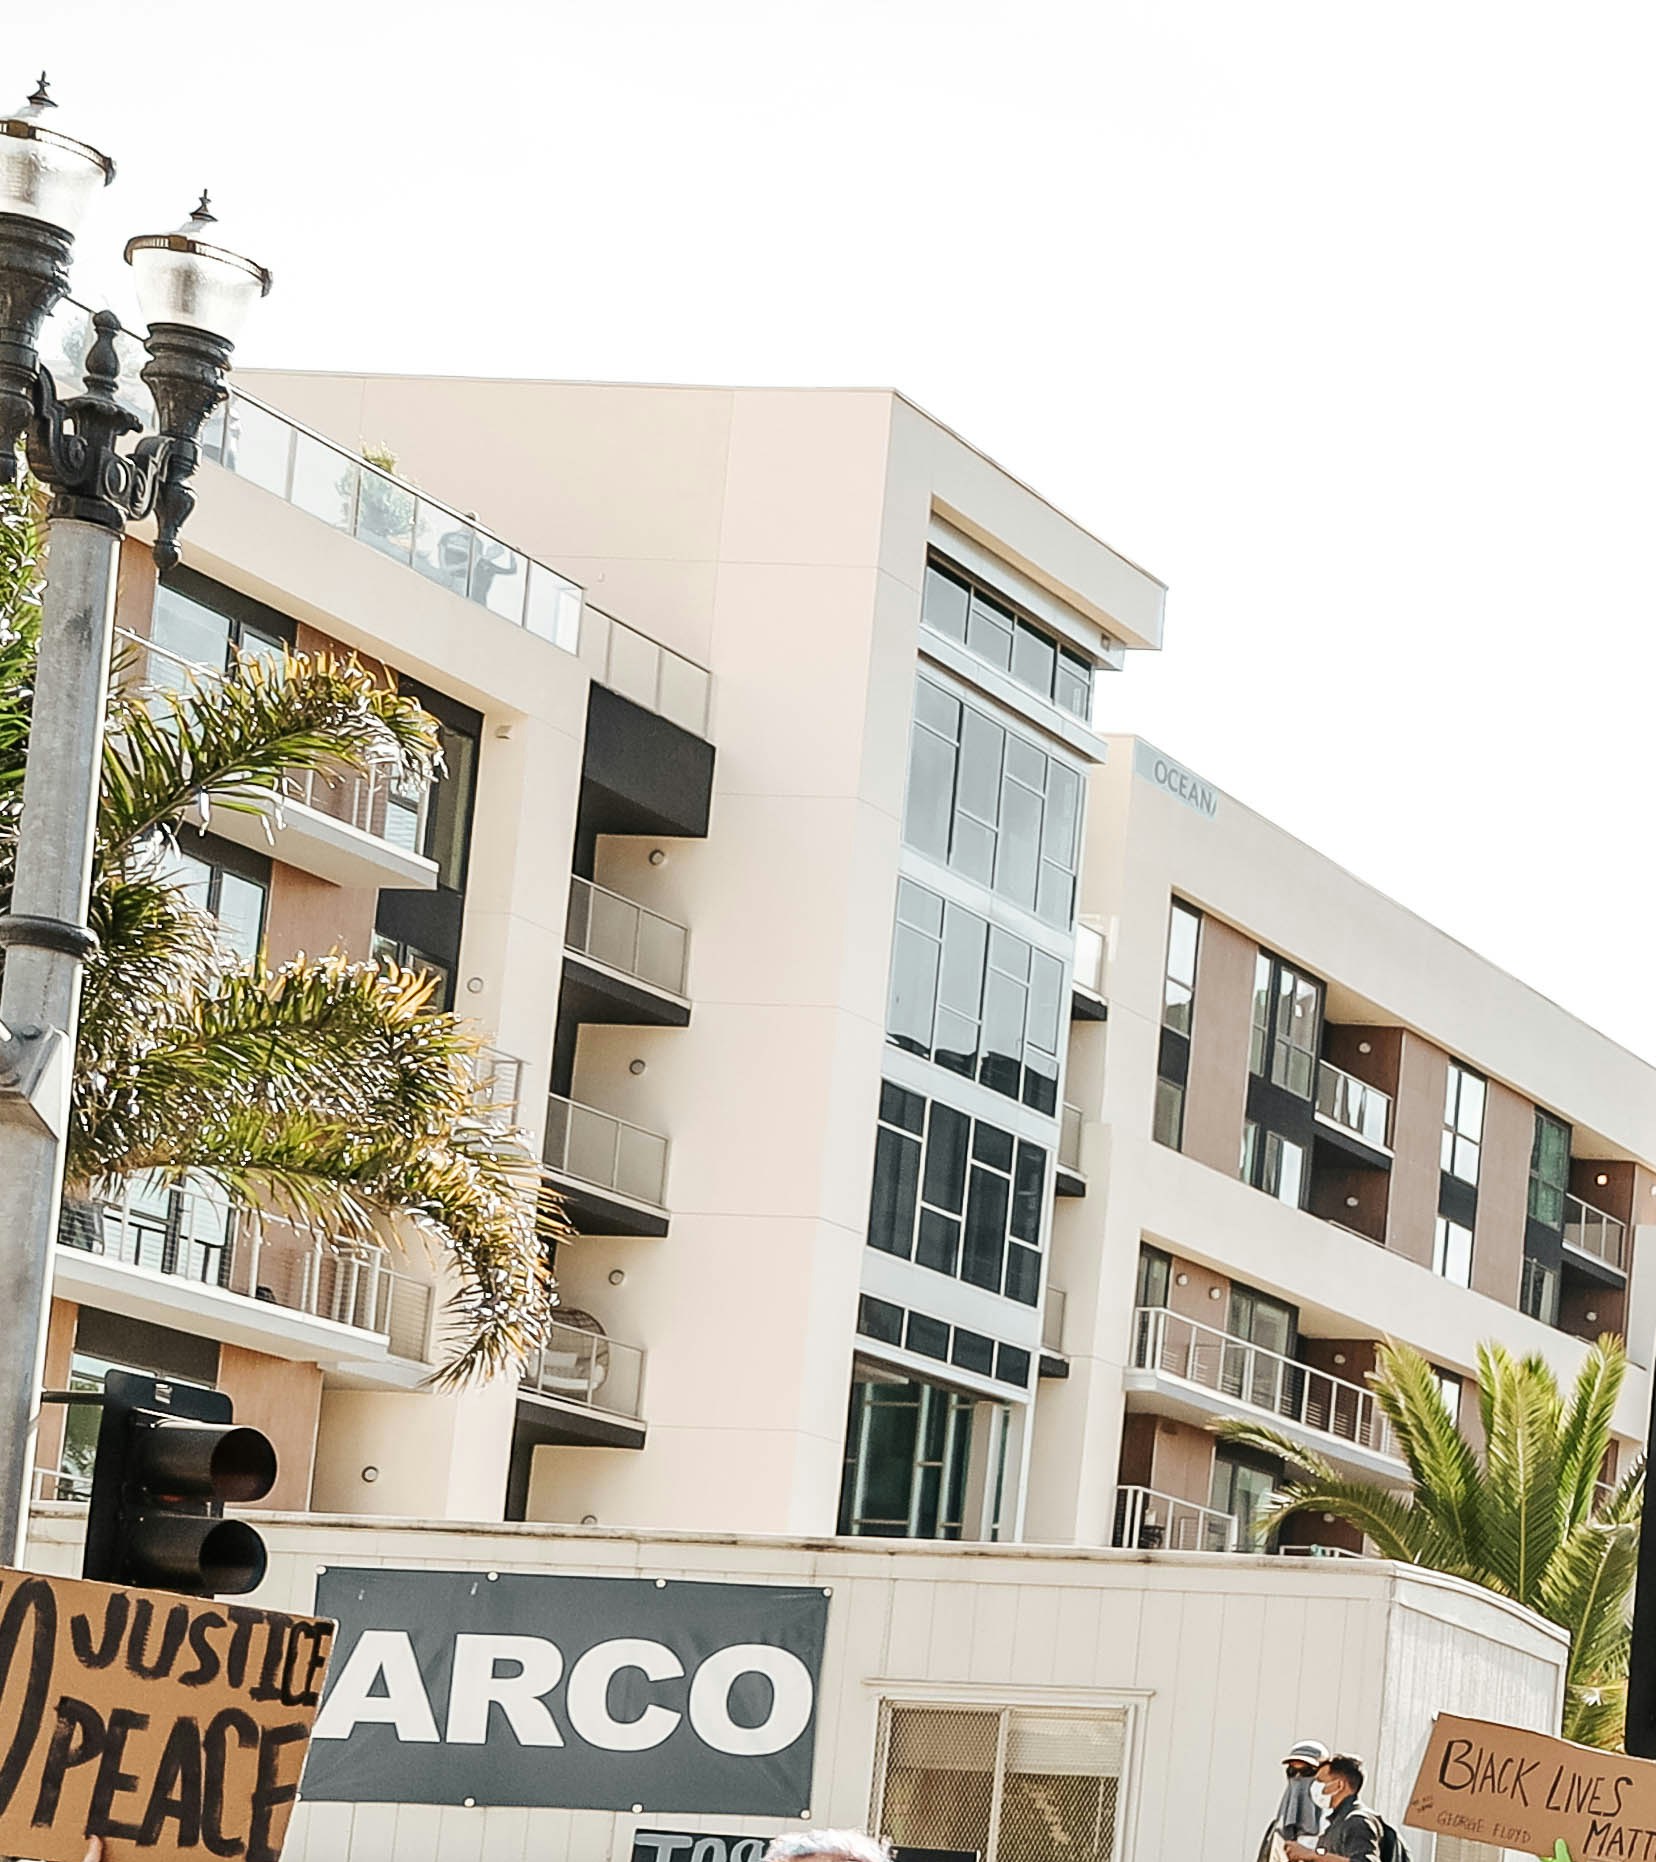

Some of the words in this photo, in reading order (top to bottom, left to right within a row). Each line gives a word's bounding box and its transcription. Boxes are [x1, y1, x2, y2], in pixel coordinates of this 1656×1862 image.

[71, 1590, 335, 1707] JUSTICE
[311, 1629, 815, 1757] ARCO
[1492, 1823, 1531, 1844] FLOYD
[1545, 1765, 1634, 1818] LIVES
